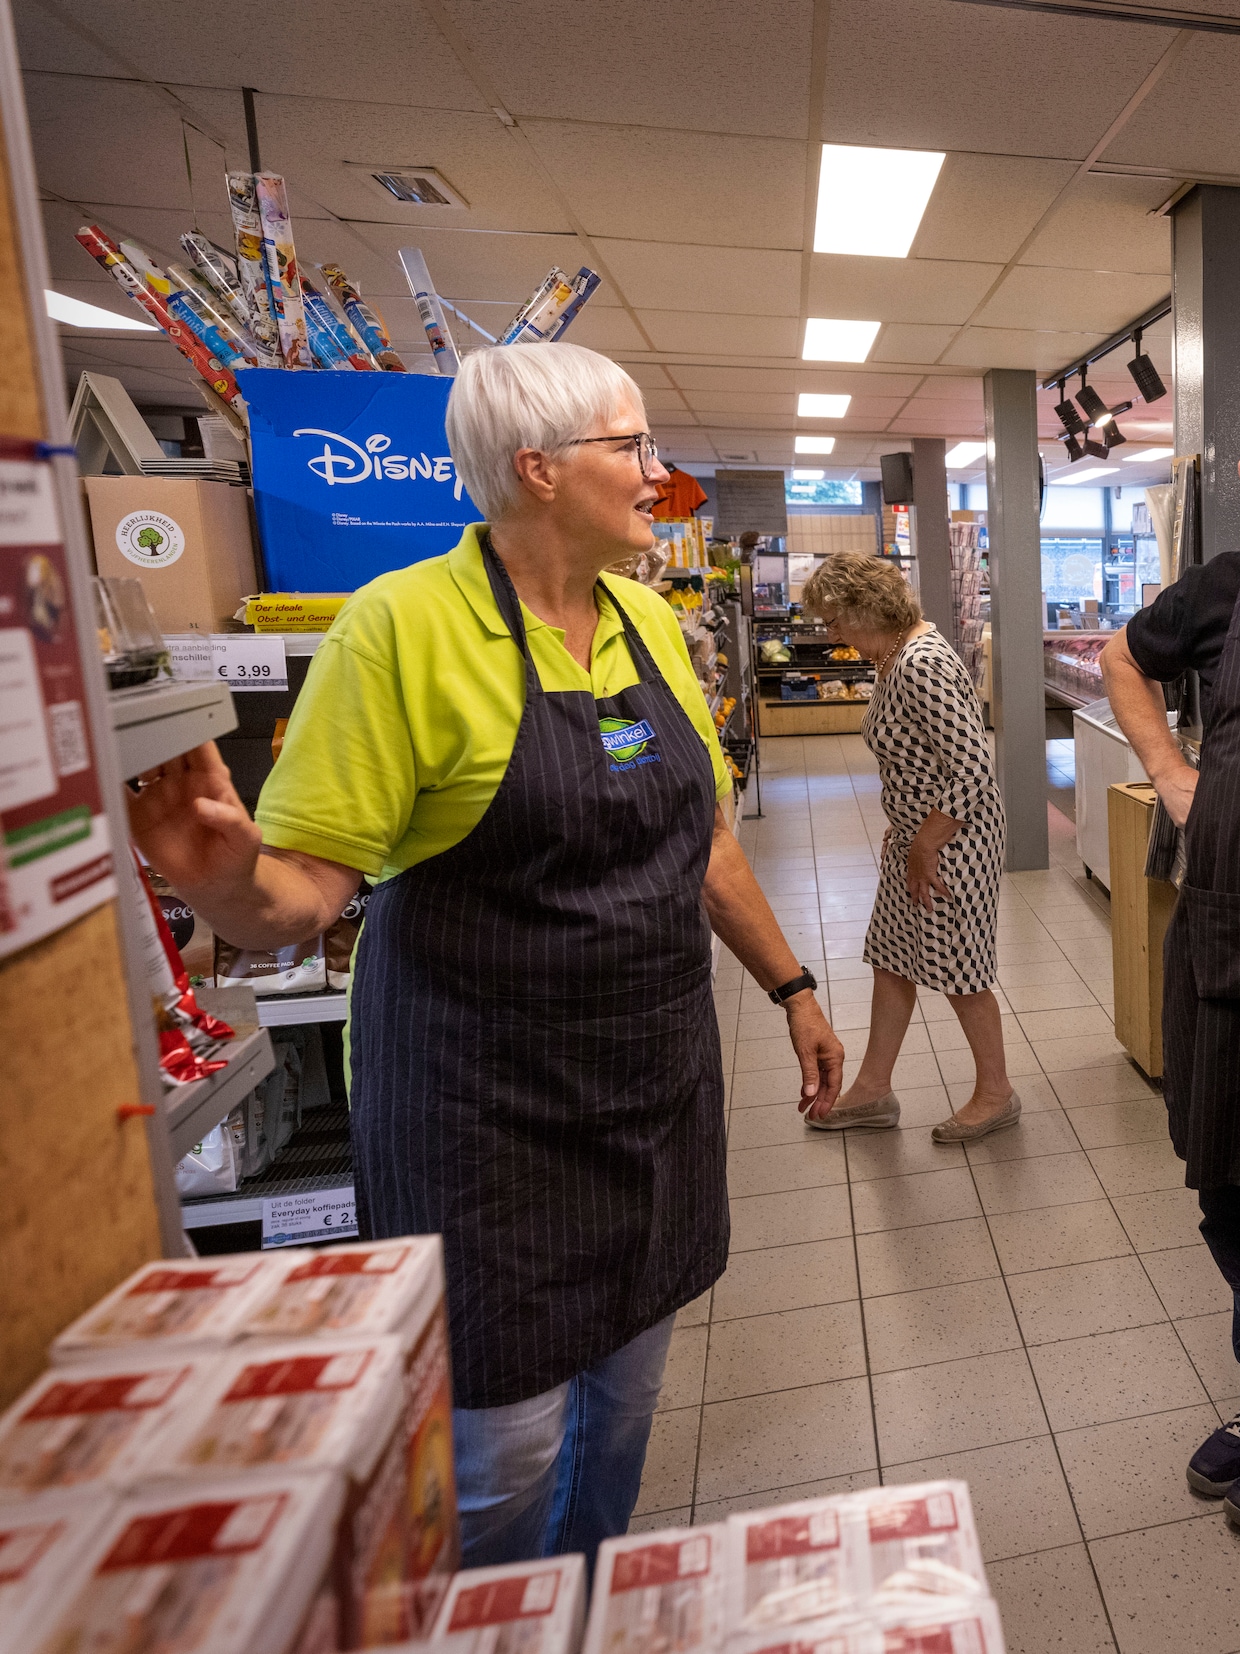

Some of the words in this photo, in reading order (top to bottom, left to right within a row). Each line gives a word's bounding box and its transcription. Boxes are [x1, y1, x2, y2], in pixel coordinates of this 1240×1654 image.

[121, 515, 175, 537] HEERLIJKHEID
[255, 604, 272, 612] Der
[275, 603, 303, 612] ideale
[257, 615, 283, 623] Obst-
[307, 614, 336, 622] Gemü
[182, 644, 227, 653] aanbieding
[218, 665, 228, 677] €
[237, 665, 271, 679] 3,99
[281, 960, 295, 968] PADS
[271, 1201, 282, 1209] Uit
[283, 1200, 293, 1208] de
[295, 1197, 316, 1207] folder
[271, 1207, 311, 1219] Everyday
[312, 1200, 357, 1214] koffiepads
[323, 1214, 333, 1226] €
